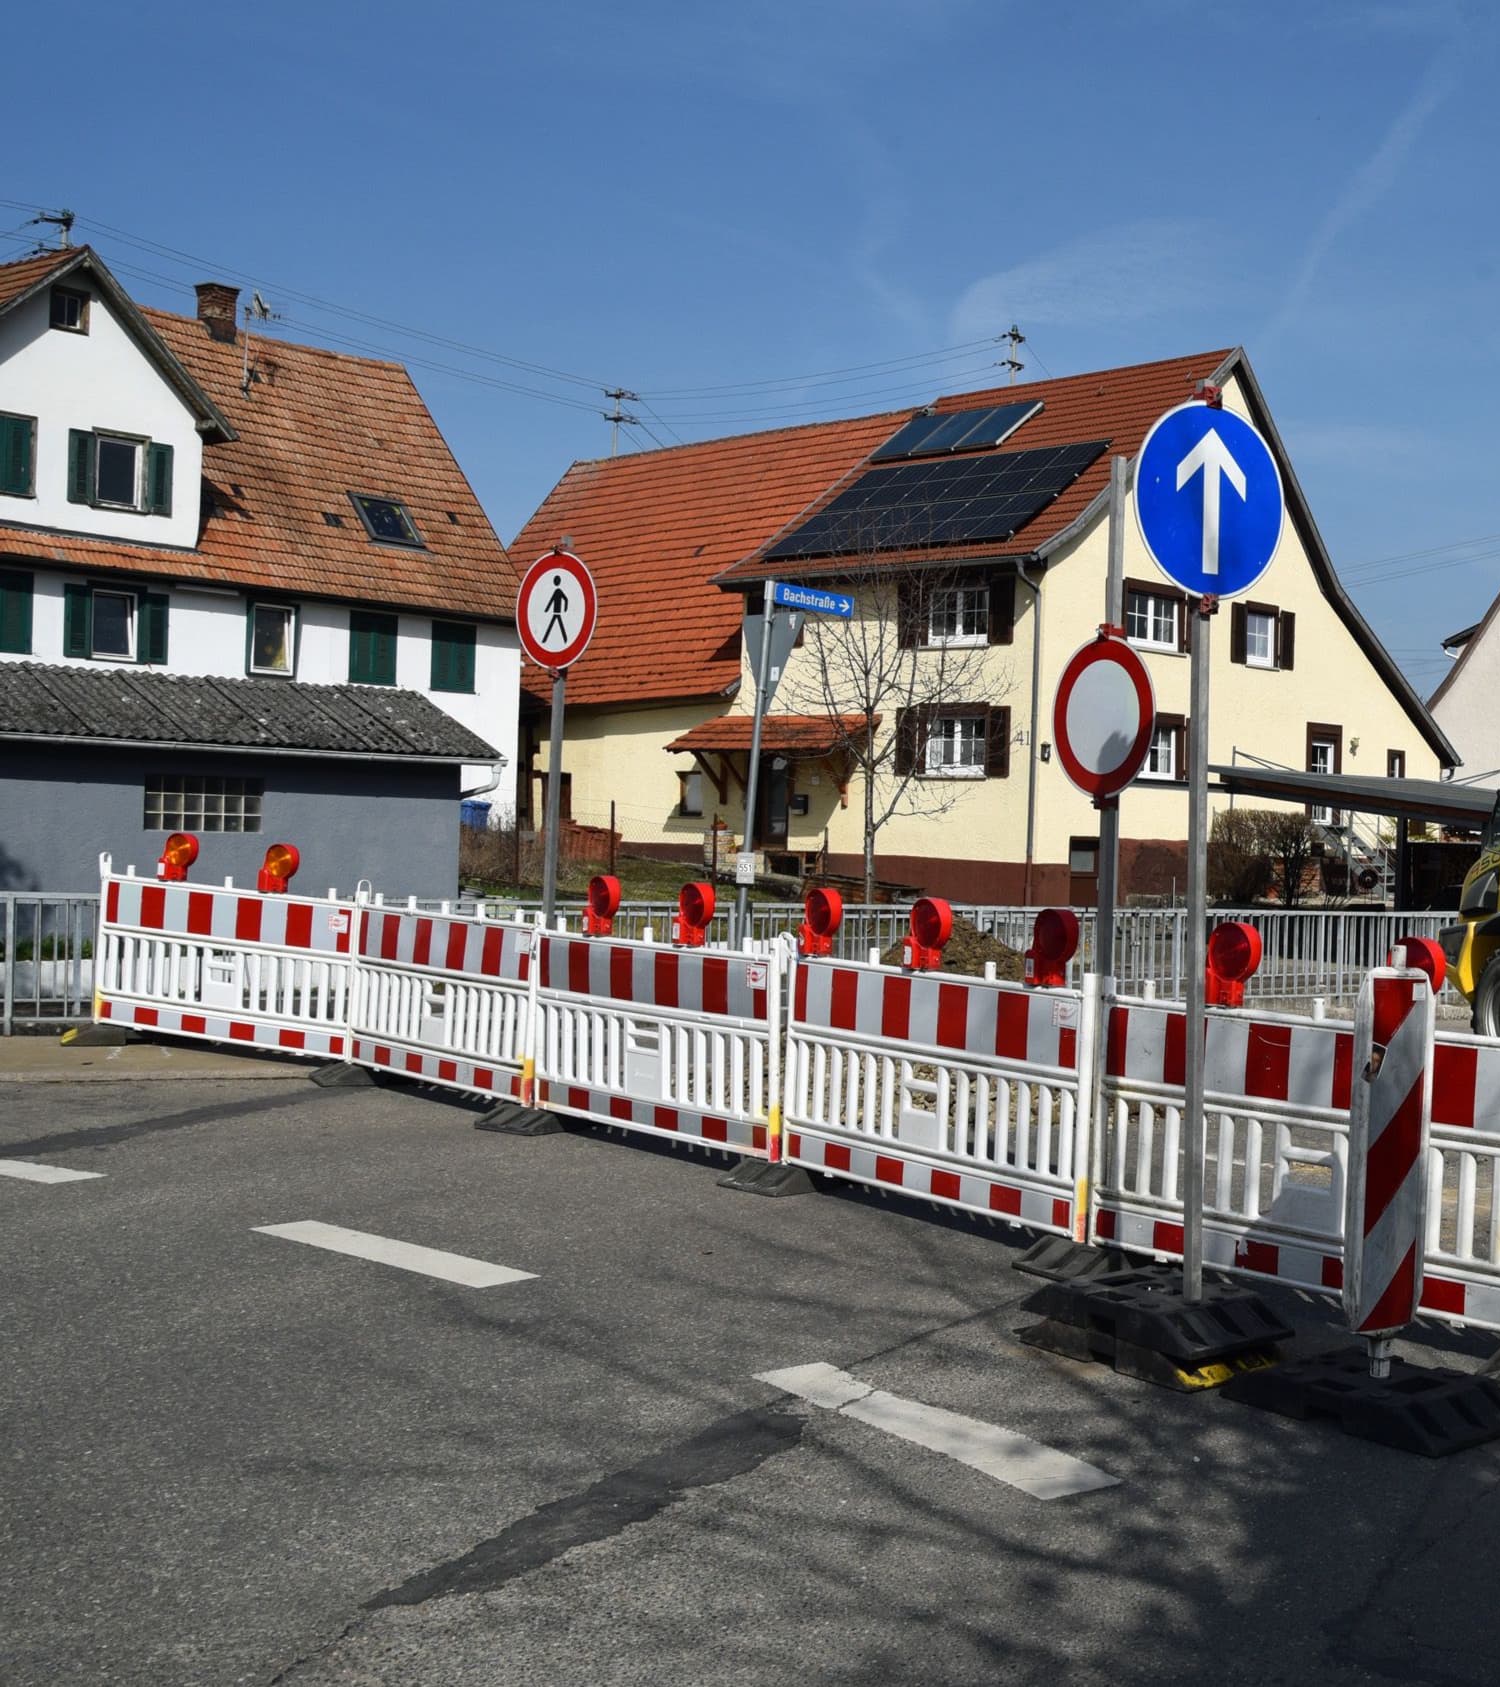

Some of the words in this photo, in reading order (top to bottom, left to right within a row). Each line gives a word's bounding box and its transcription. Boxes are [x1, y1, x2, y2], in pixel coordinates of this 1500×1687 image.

[783, 588, 836, 610] Bachstraße
[1015, 730, 1030, 745] 41
[739, 863, 752, 872] 551
